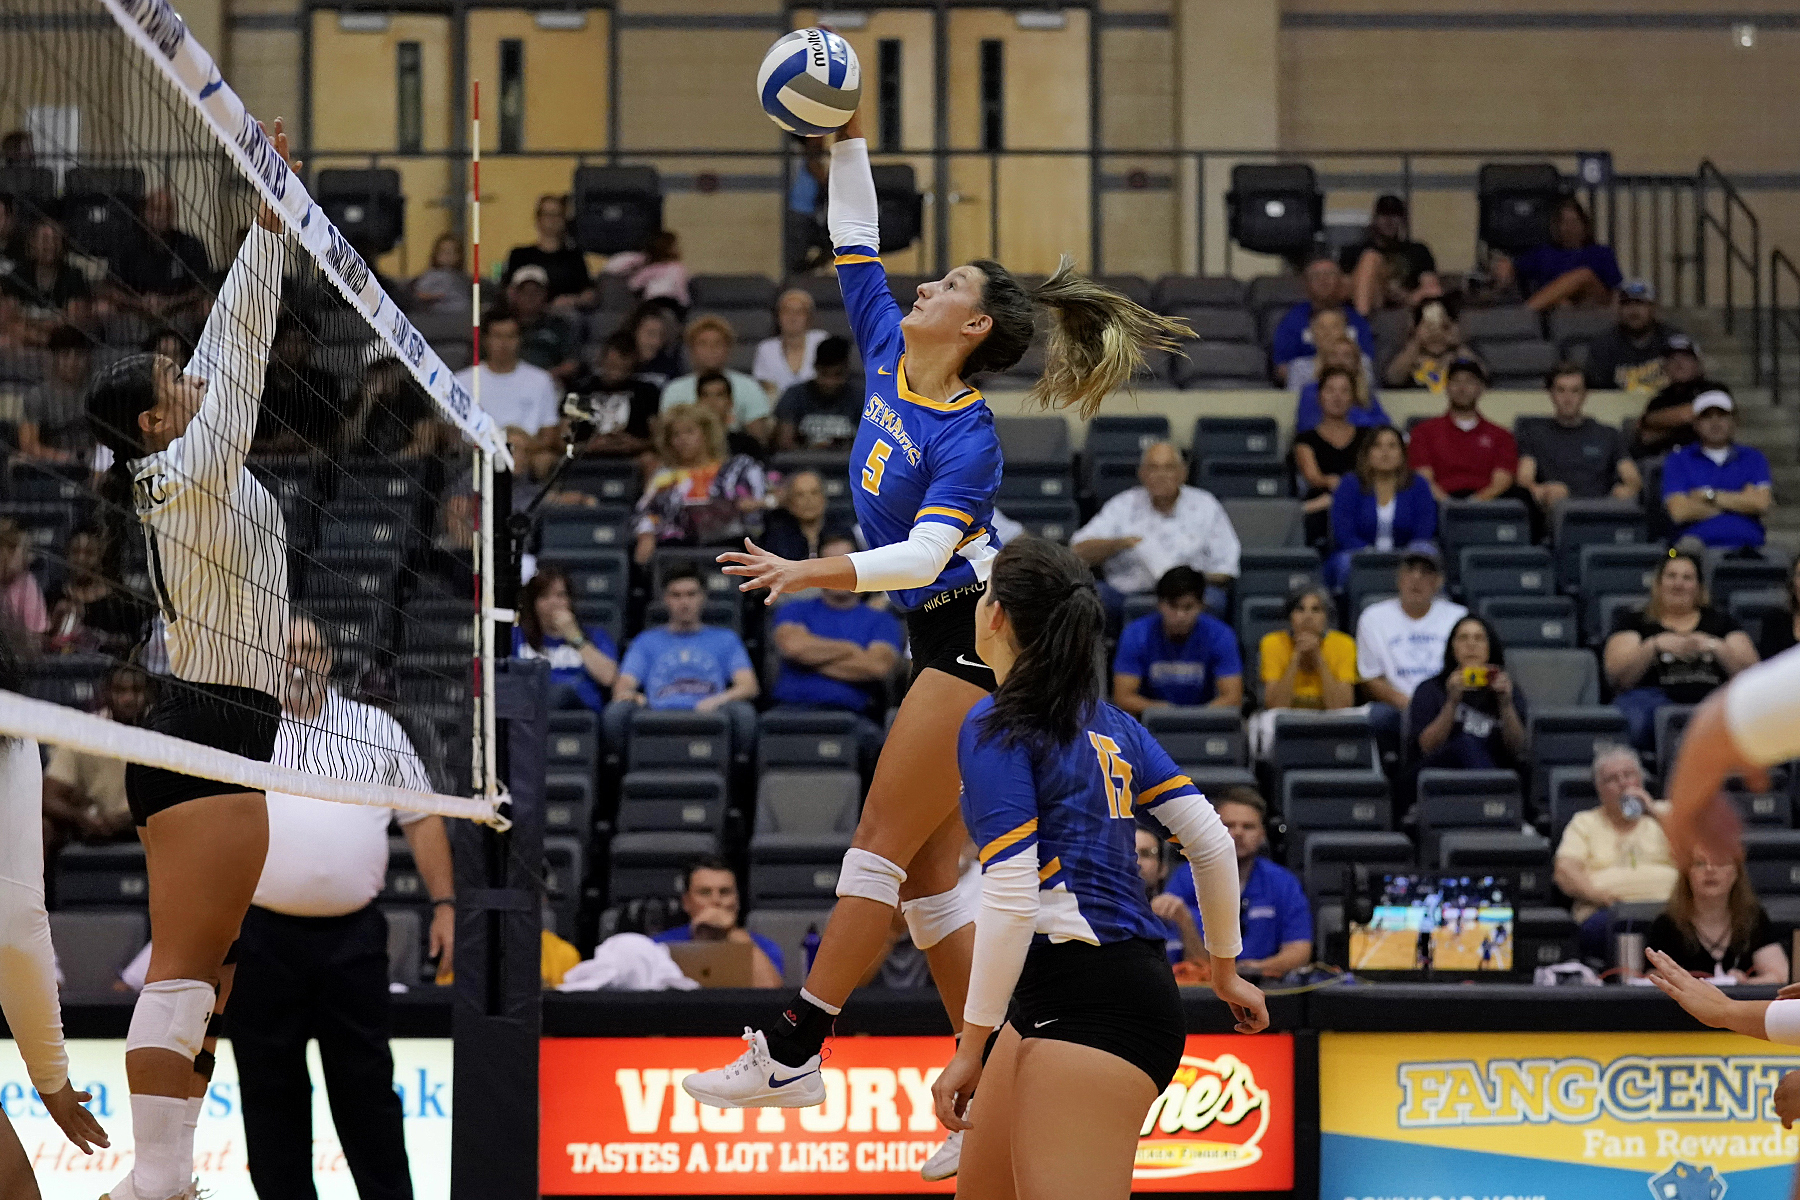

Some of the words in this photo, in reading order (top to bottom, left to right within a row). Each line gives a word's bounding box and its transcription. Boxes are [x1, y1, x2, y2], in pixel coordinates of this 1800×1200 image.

[806, 29, 826, 67] molte
[862, 438, 893, 496] 5
[923, 591, 951, 612] NIKE
[1087, 731, 1135, 819] 15
[1400, 1060, 1599, 1127] FANG
[567, 1143, 680, 1173] TASTES
[685, 1143, 711, 1172] A
[715, 1142, 774, 1172] LOT
[779, 1142, 850, 1172] LIKE
[1583, 1129, 1646, 1158] Fan
[1656, 1124, 1799, 1158] Rewards
